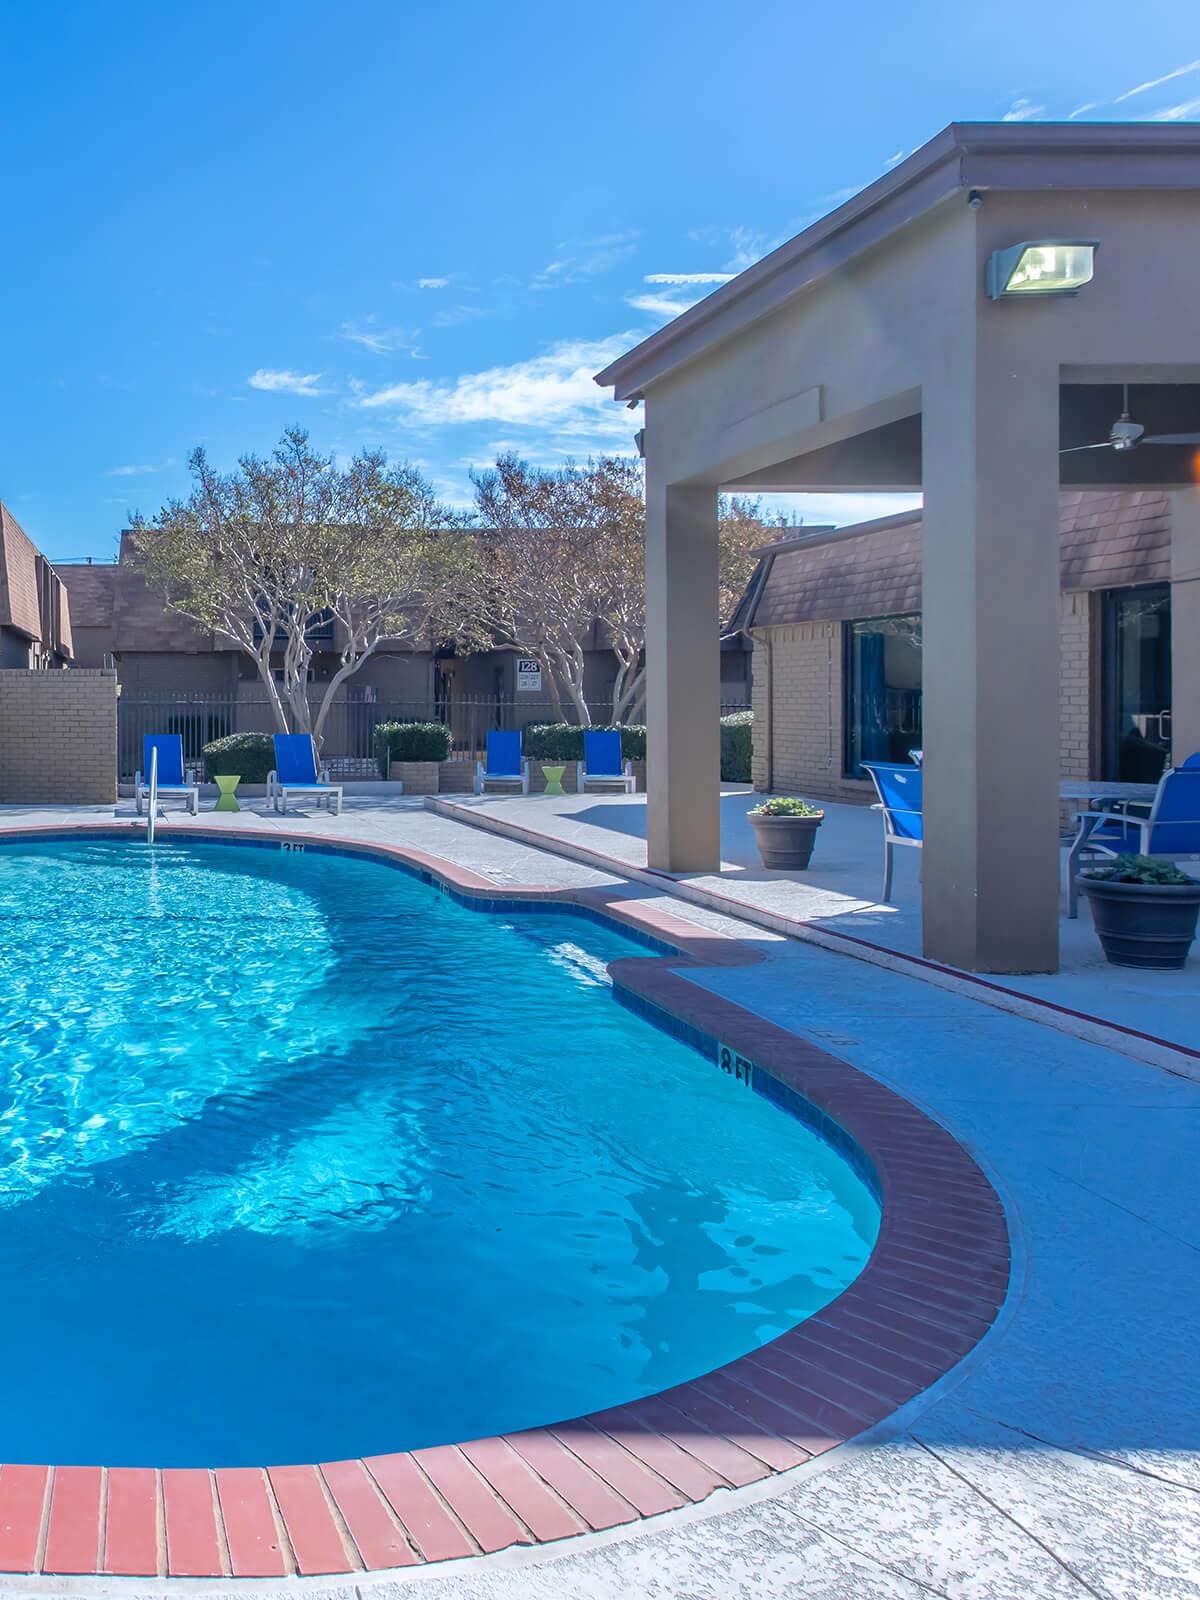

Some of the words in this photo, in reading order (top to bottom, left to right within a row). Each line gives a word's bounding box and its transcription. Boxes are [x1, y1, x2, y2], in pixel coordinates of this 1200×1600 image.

[520, 661, 537, 671] 128
[720, 1047, 732, 1075] 8
[735, 1055, 751, 1088] FT
